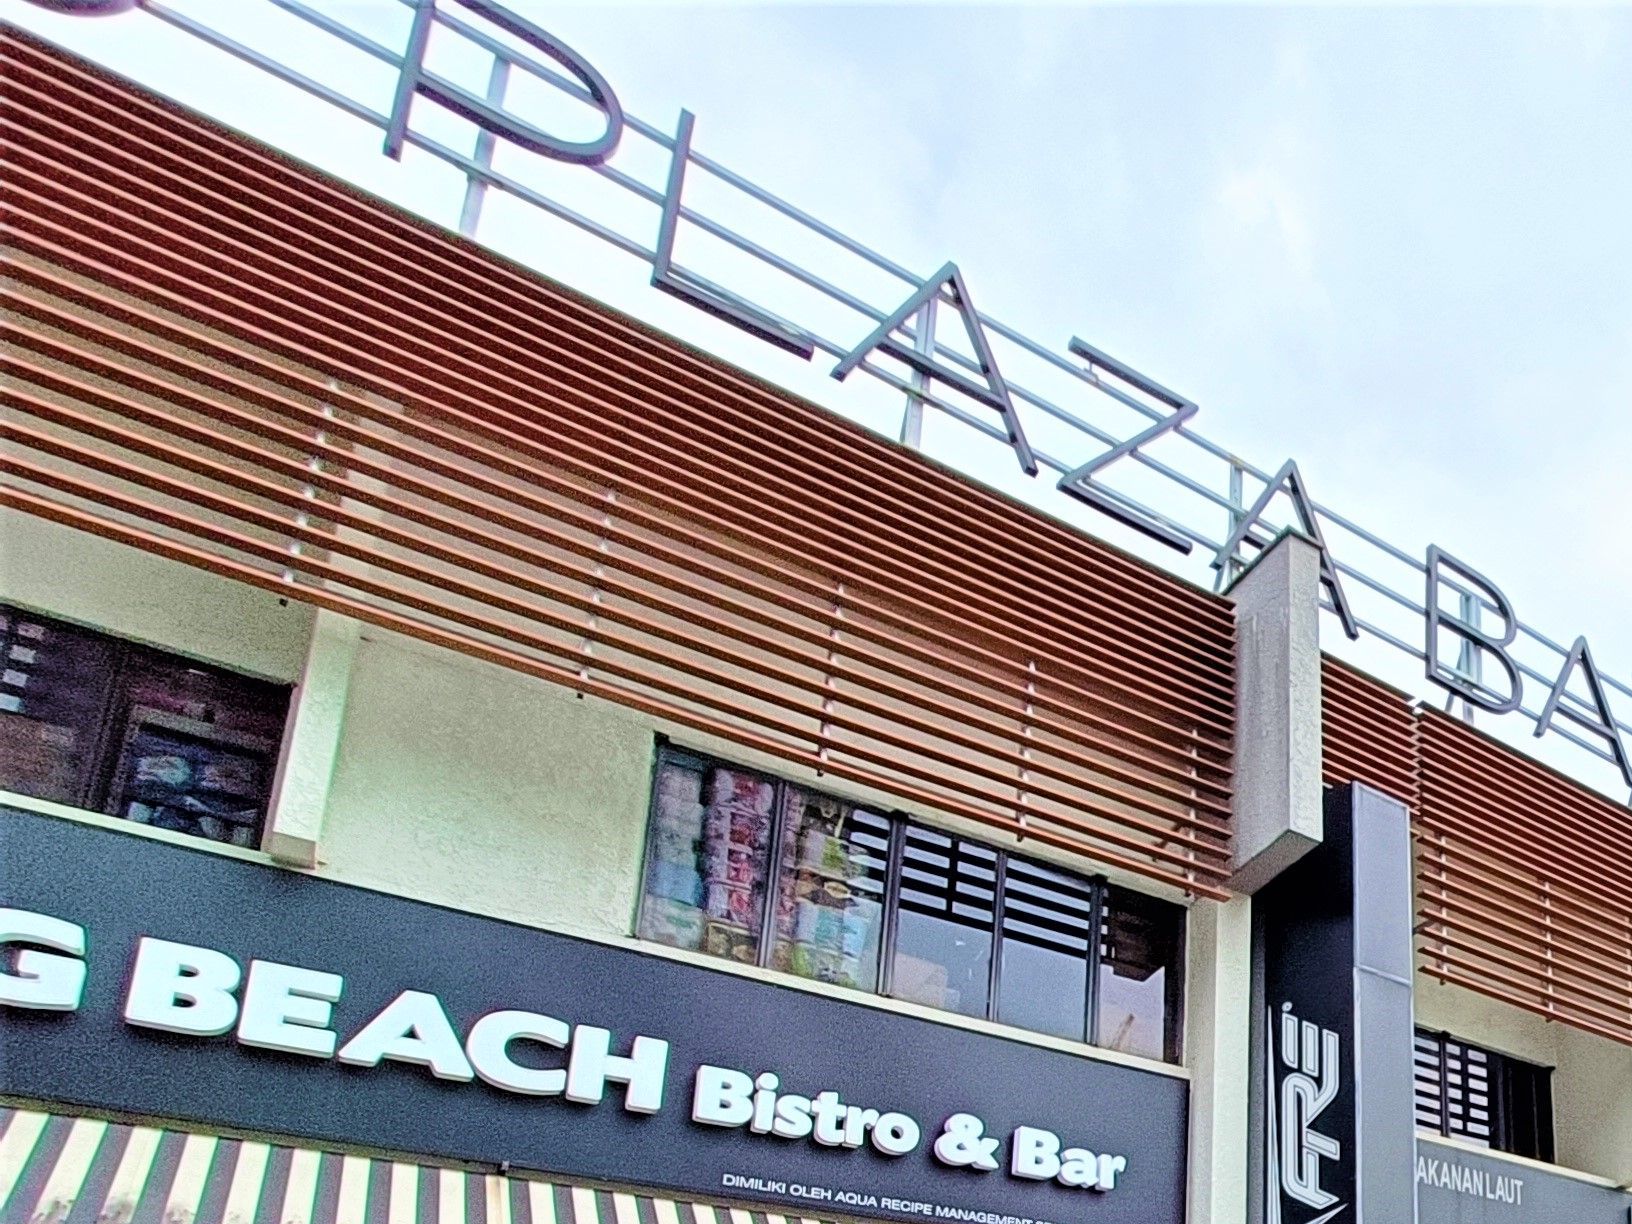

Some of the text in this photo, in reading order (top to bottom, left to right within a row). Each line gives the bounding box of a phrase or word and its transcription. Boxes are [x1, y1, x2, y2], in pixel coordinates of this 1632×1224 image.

[383, 0, 1360, 642] PLAZA
[125, 936, 669, 1114] BEACH
[692, 1063, 920, 1156] Bistro
[934, 1112, 999, 1172] &
[1011, 1124, 1128, 1192] Bar
[722, 1173, 786, 1194] DIMILIKI
[789, 1183, 832, 1201] OLEH
[834, 1190, 878, 1208] AQUA
[880, 1197, 933, 1216] RECIPE
[1485, 1172, 1524, 1206] LAUT
